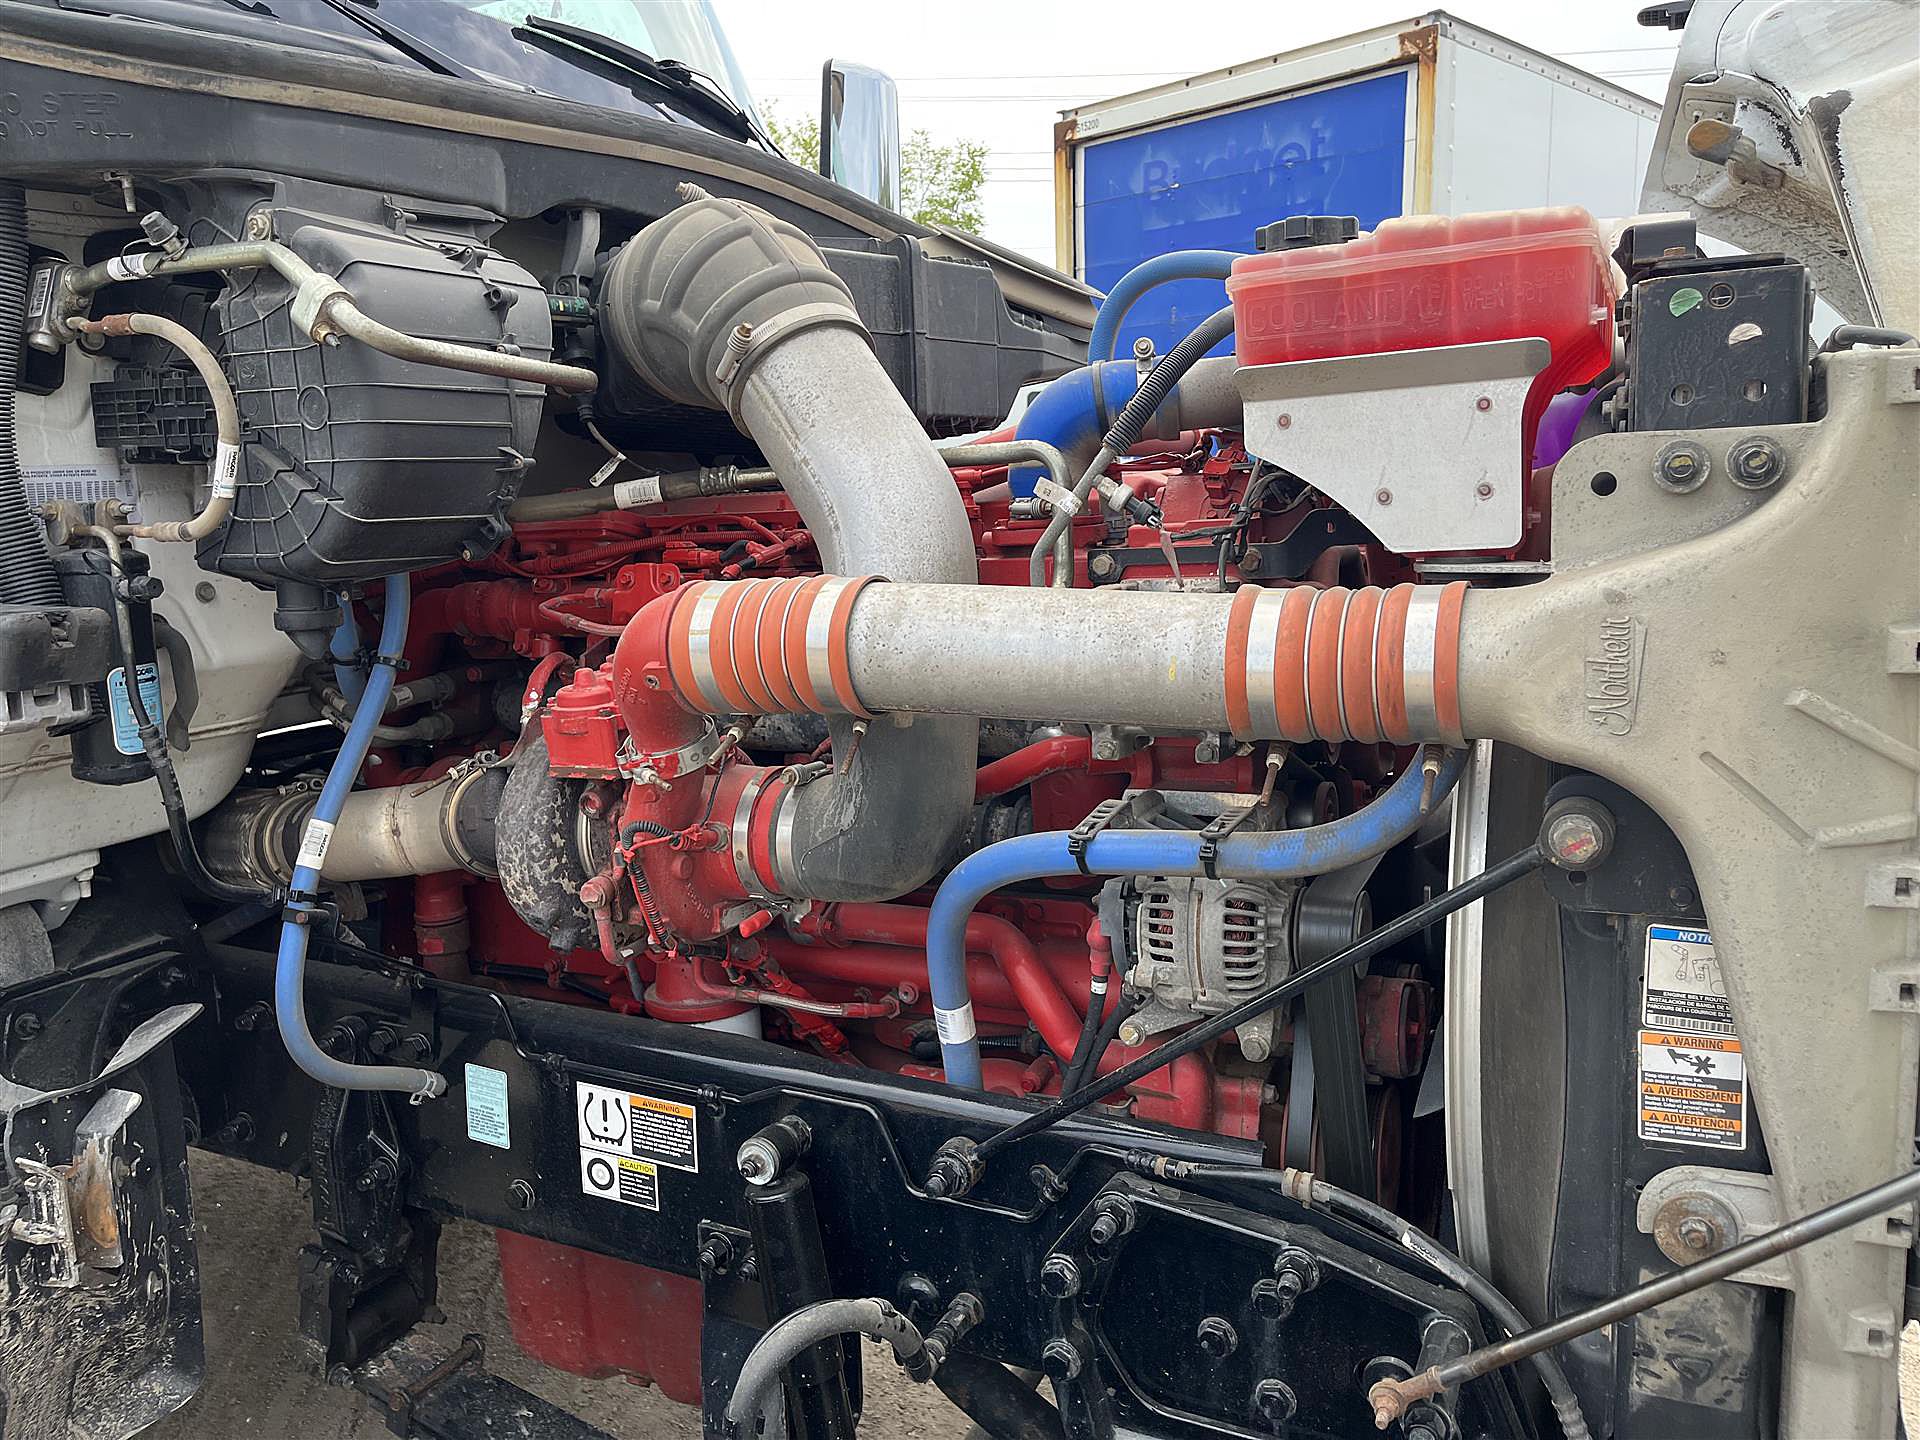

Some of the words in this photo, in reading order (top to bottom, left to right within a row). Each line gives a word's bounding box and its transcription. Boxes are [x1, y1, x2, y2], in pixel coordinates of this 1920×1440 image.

[0, 90, 21, 115] O
[42, 91, 121, 115] STEP
[21, 119, 58, 137] NOT
[72, 119, 134, 138] PULL
[1673, 1036, 1724, 1050] WARNING
[1658, 1086, 1740, 1103] AVERTISSEMENT
[648, 1101, 680, 1113] WARNING
[1662, 1113, 1735, 1130] ADVERTENCIA
[624, 1161, 654, 1174] CAUTION
